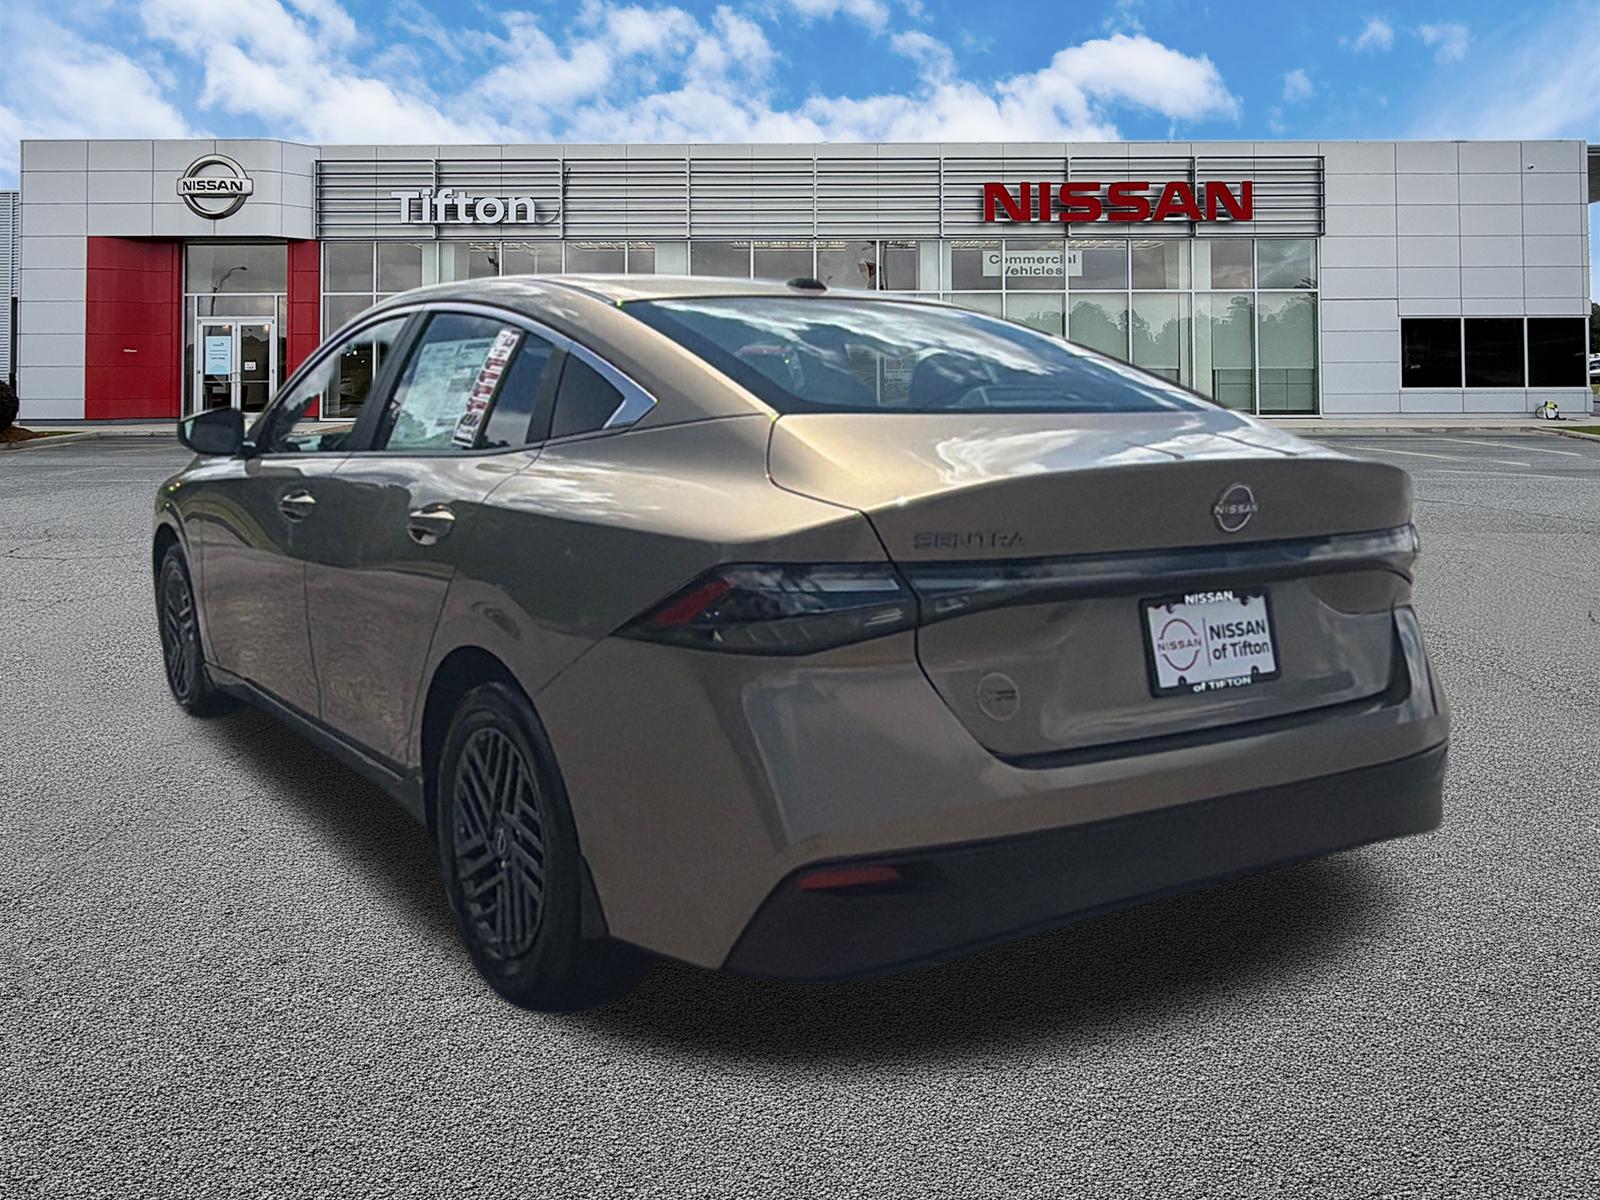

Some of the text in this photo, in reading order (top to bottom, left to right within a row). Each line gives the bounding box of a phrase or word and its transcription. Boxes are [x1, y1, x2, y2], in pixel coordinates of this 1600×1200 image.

[183, 181, 243, 191] NISSAN
[391, 188, 536, 224] Tifton
[983, 181, 1253, 222] NISSAN
[1213, 503, 1258, 514] NISSAN
[913, 531, 1024, 549] SENTRA
[1184, 590, 1233, 605] NISSAN
[1209, 620, 1266, 641] NISSAN
[1157, 639, 1202, 652] NISSAN
[1212, 640, 1270, 660] of Tifton
[1193, 676, 1252, 693] of TIFTON
